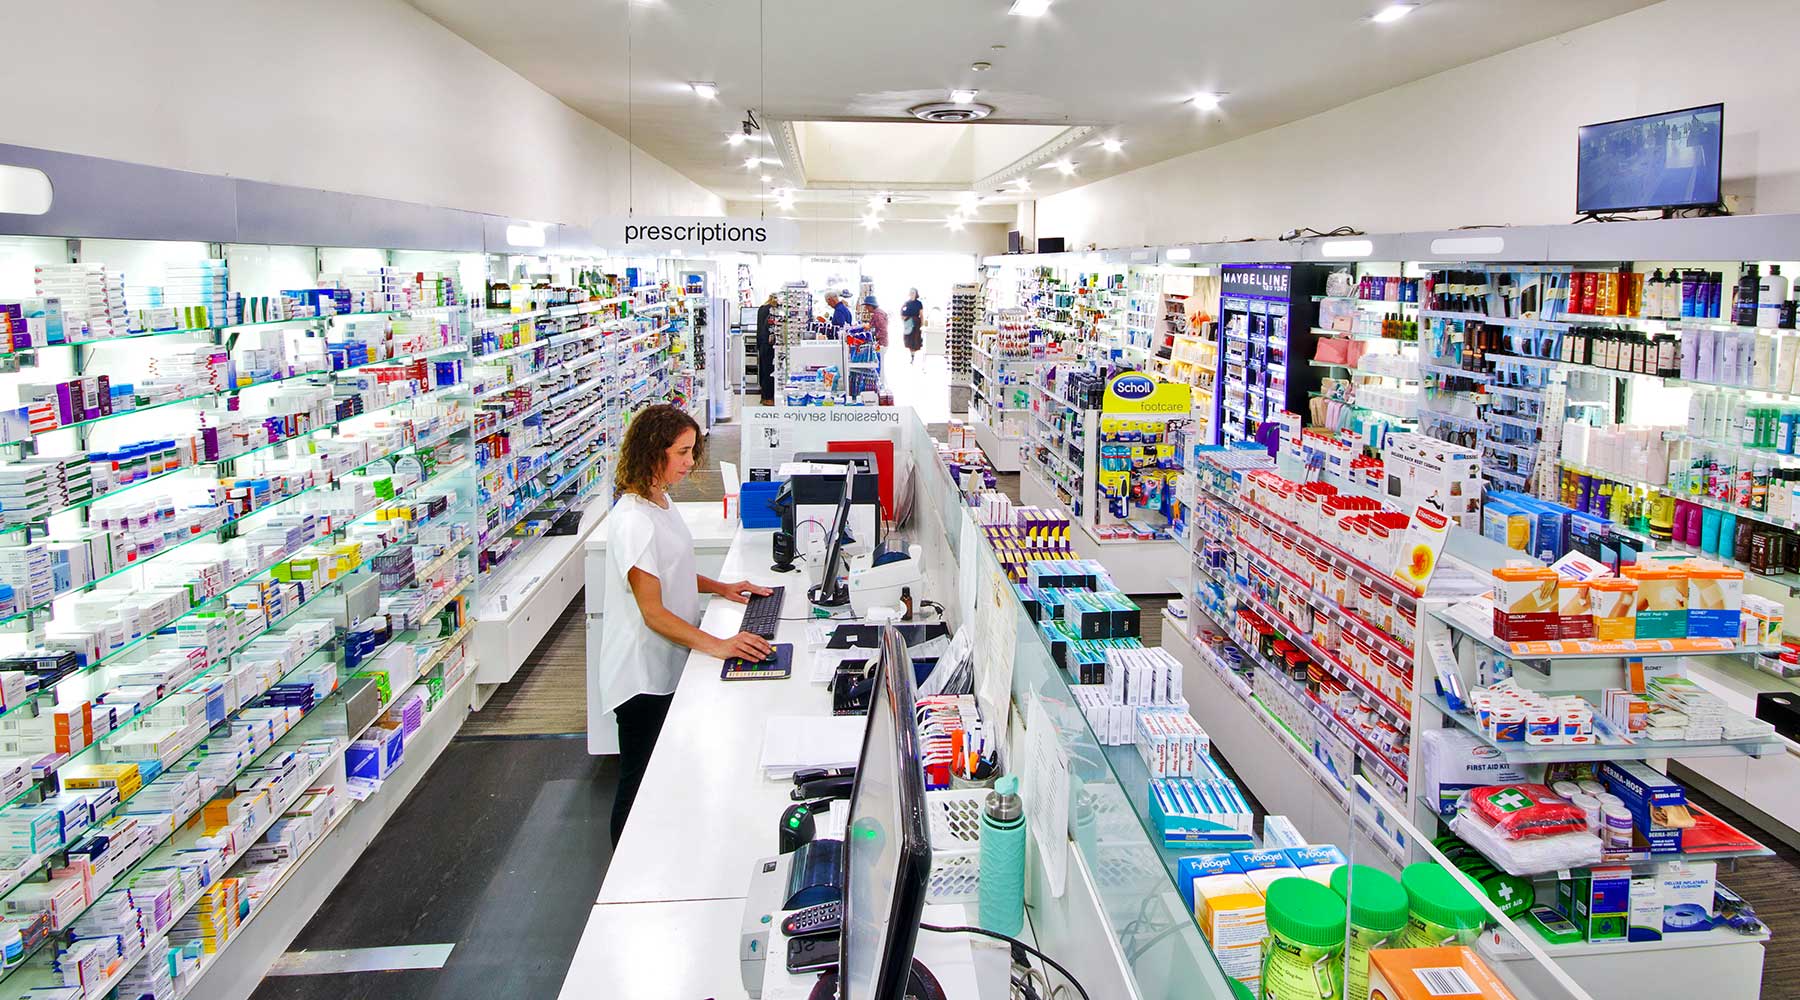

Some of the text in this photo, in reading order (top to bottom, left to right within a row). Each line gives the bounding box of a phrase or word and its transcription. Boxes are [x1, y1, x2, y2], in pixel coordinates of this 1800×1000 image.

[625, 222, 767, 245] prescriptions
[1223, 273, 1289, 287] MAYBELLINE
[1117, 382, 1150, 393] Scholl
[1140, 402, 1184, 411] footcare
[1602, 764, 1643, 795] DERMA-HOSE
[1243, 853, 1283, 864] Fybogel
[1297, 849, 1338, 859] Fybogel
[1191, 857, 1231, 870] Fybogel
[1512, 899, 1523, 907] AID
